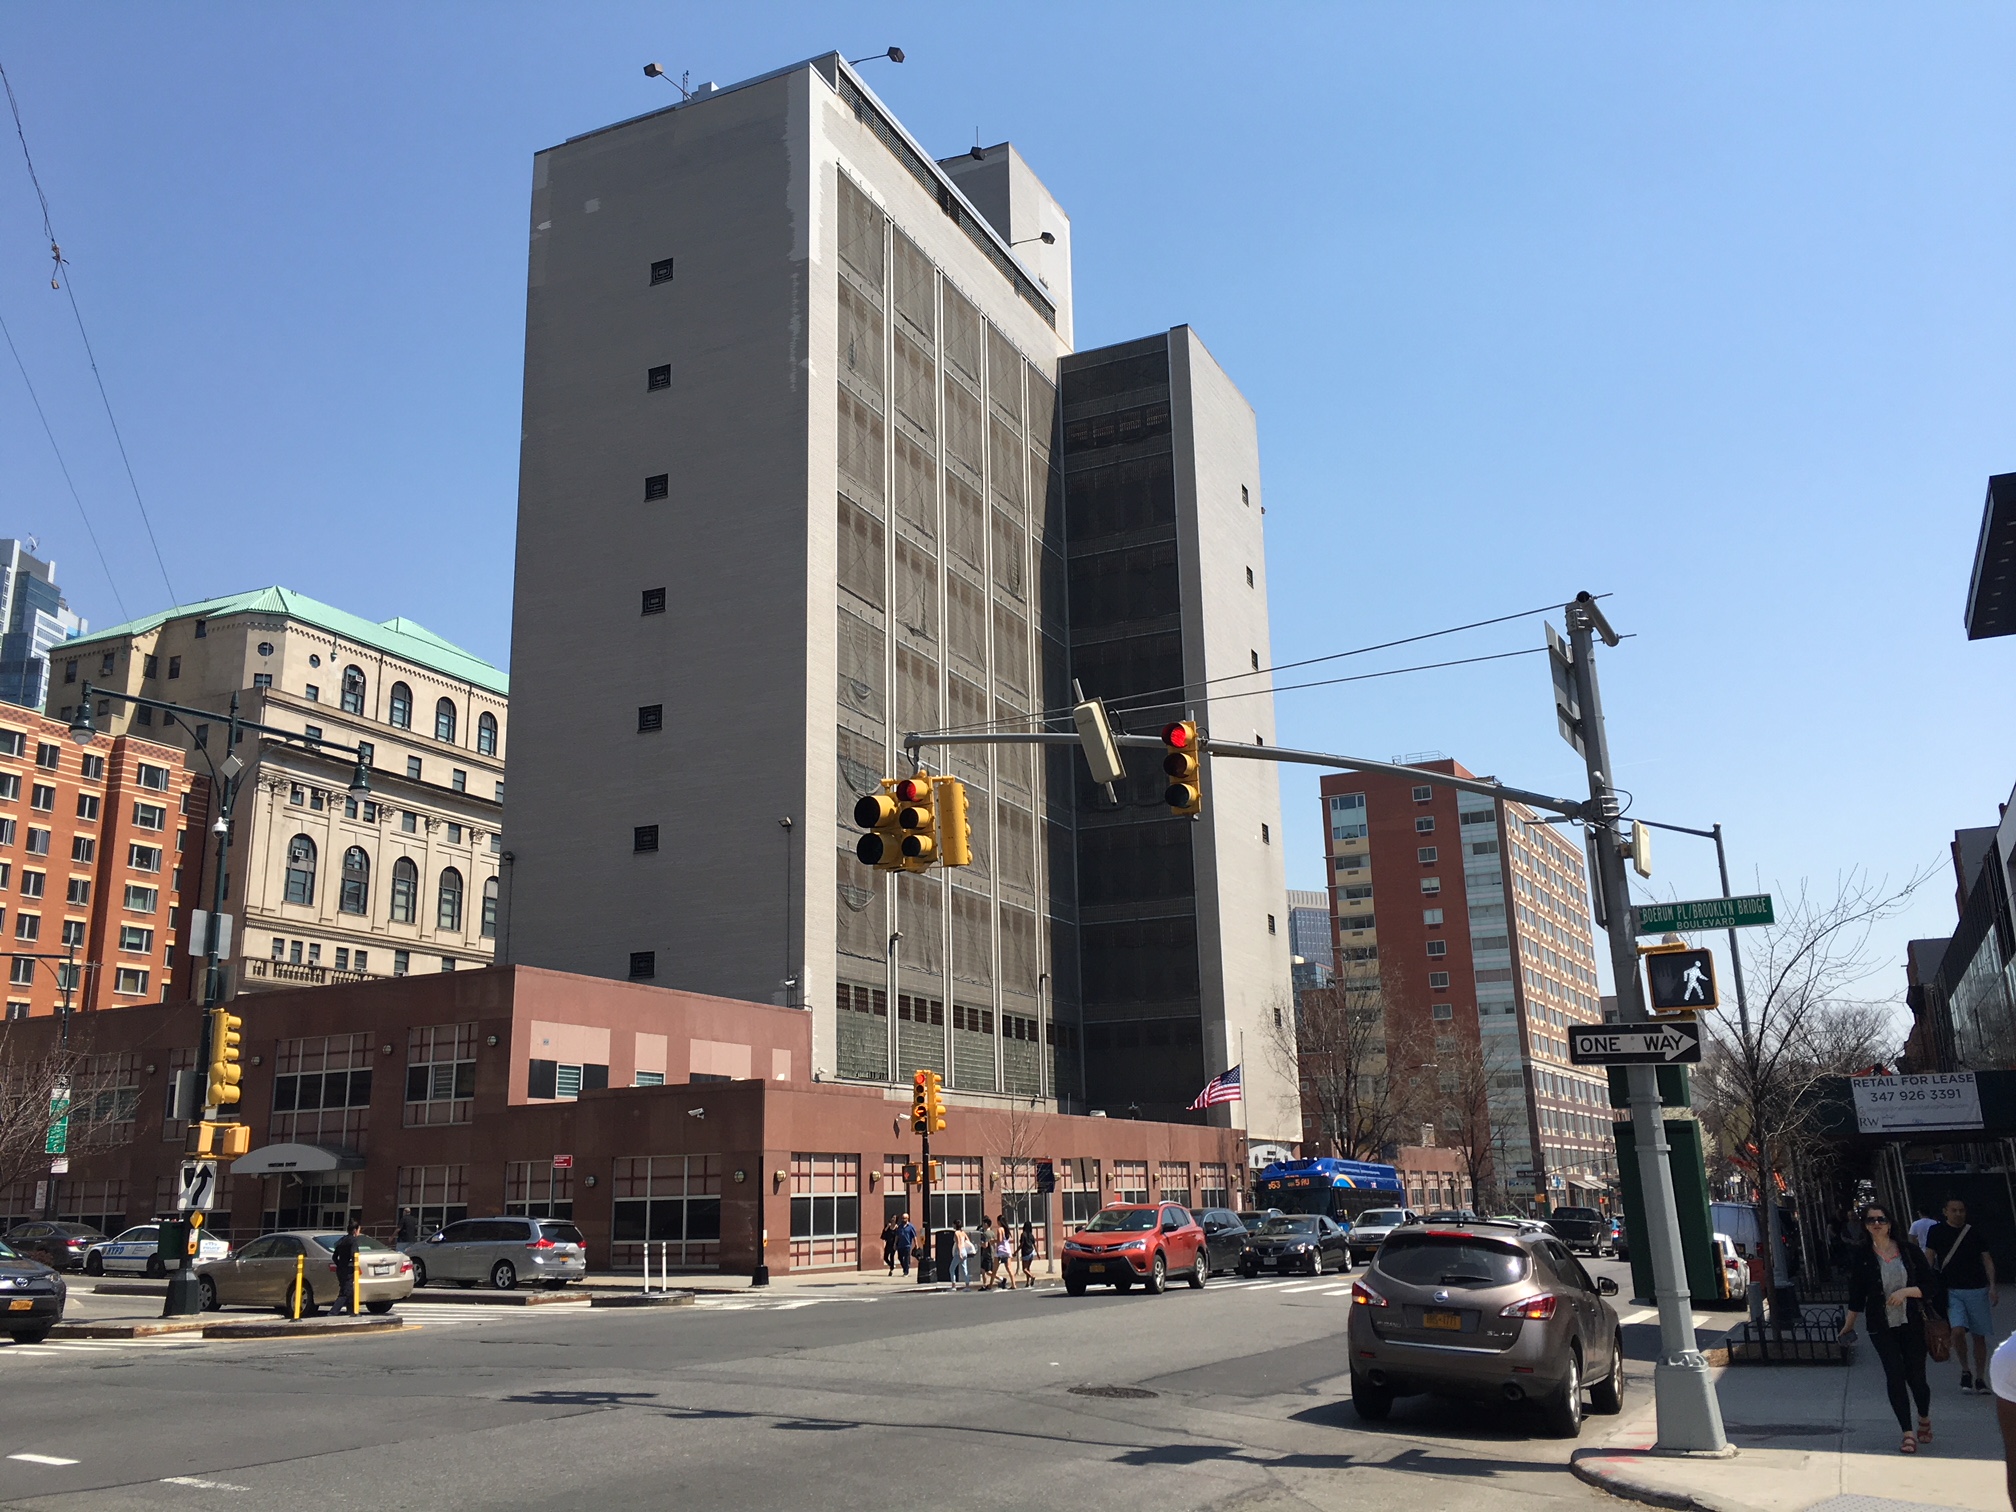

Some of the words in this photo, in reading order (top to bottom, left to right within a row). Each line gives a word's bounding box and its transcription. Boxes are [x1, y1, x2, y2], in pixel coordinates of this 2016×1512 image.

[1642, 905, 1674, 923] BOERUM
[1737, 897, 1768, 915] BRIDGE
[1676, 917, 1736, 930] BOULEVARD
[1580, 1036, 1622, 1053] ONE
[1643, 1034, 1684, 1051] WAY
[1853, 1078, 1898, 1088] RETAIL
[1901, 1076, 1929, 1086] FOR
[1932, 1073, 1975, 1084] LEASE
[1870, 1091, 1895, 1102] 347
[1899, 1090, 1926, 1101] 926
[1930, 1088, 1962, 1100] 3391
[1859, 1116, 1880, 1127] RW
[106, 1246, 125, 1255] NYPD
